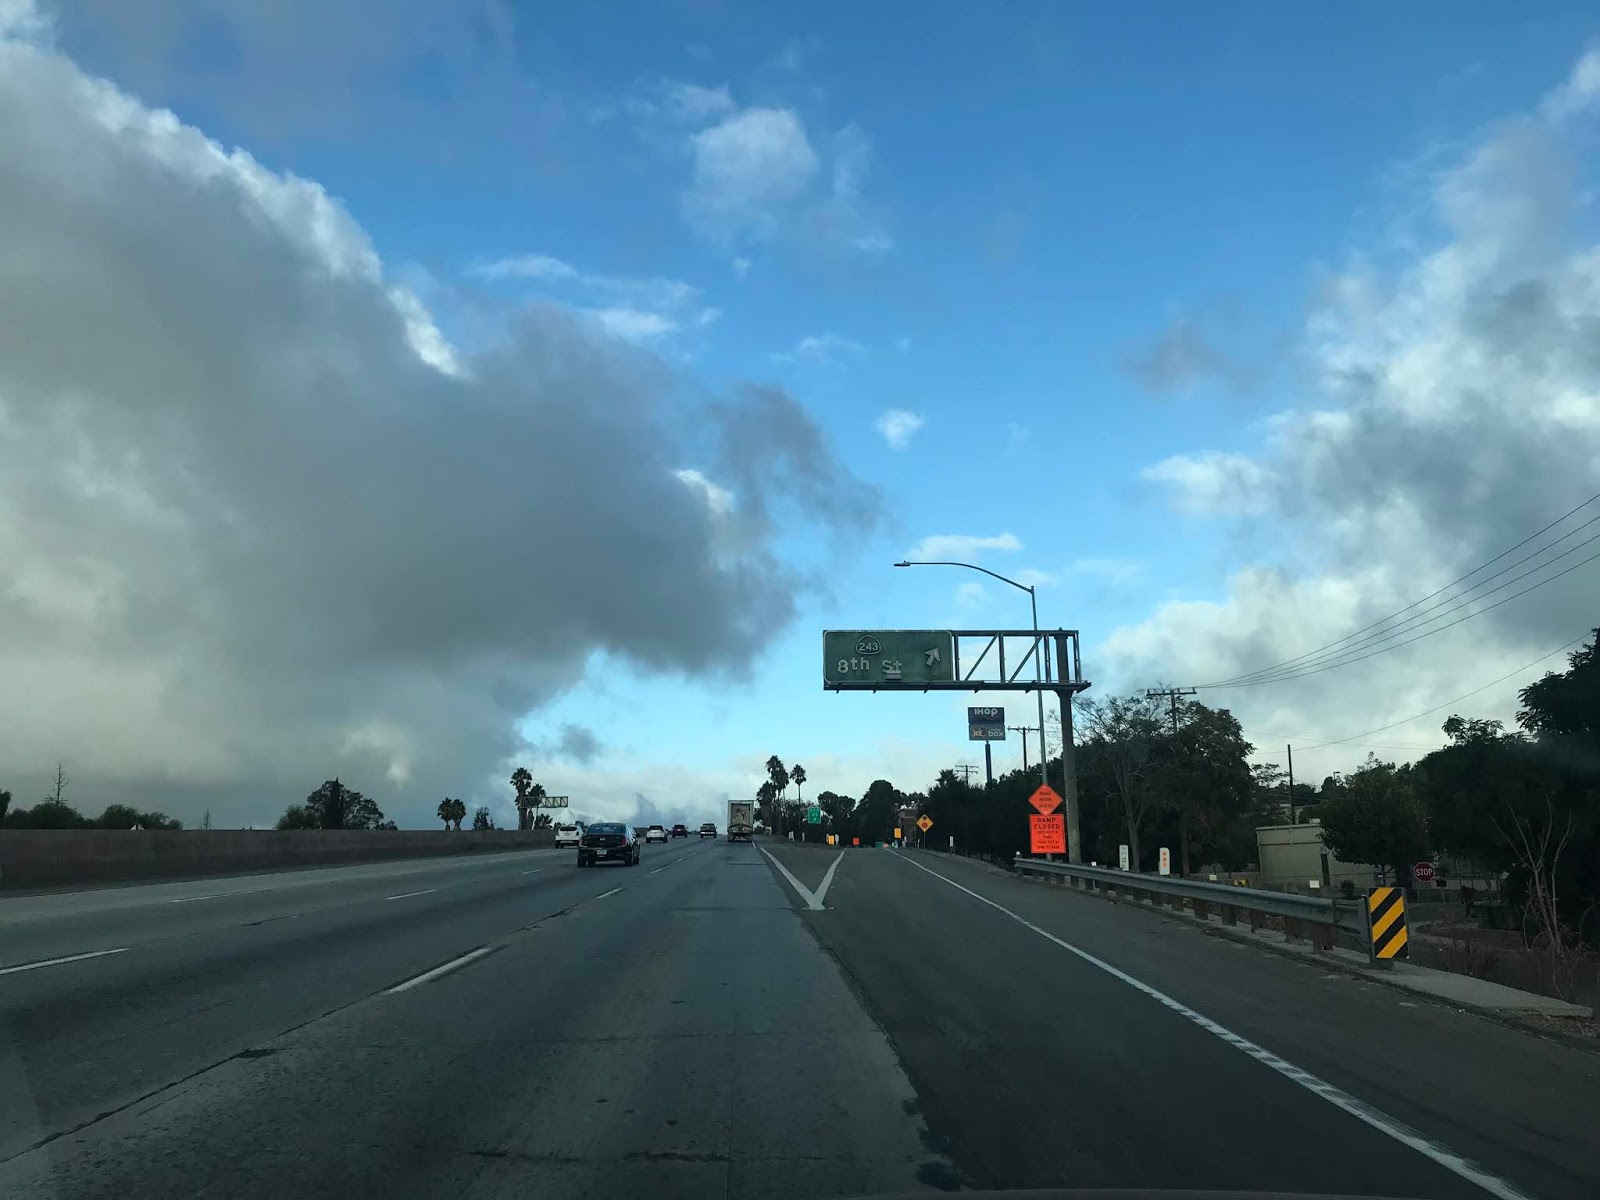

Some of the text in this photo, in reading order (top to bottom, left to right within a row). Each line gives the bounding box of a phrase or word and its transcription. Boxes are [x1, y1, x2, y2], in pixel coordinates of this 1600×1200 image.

[859, 642, 879, 651] 243
[837, 657, 902, 674] 8th St
[1415, 868, 1433, 877] STOP
